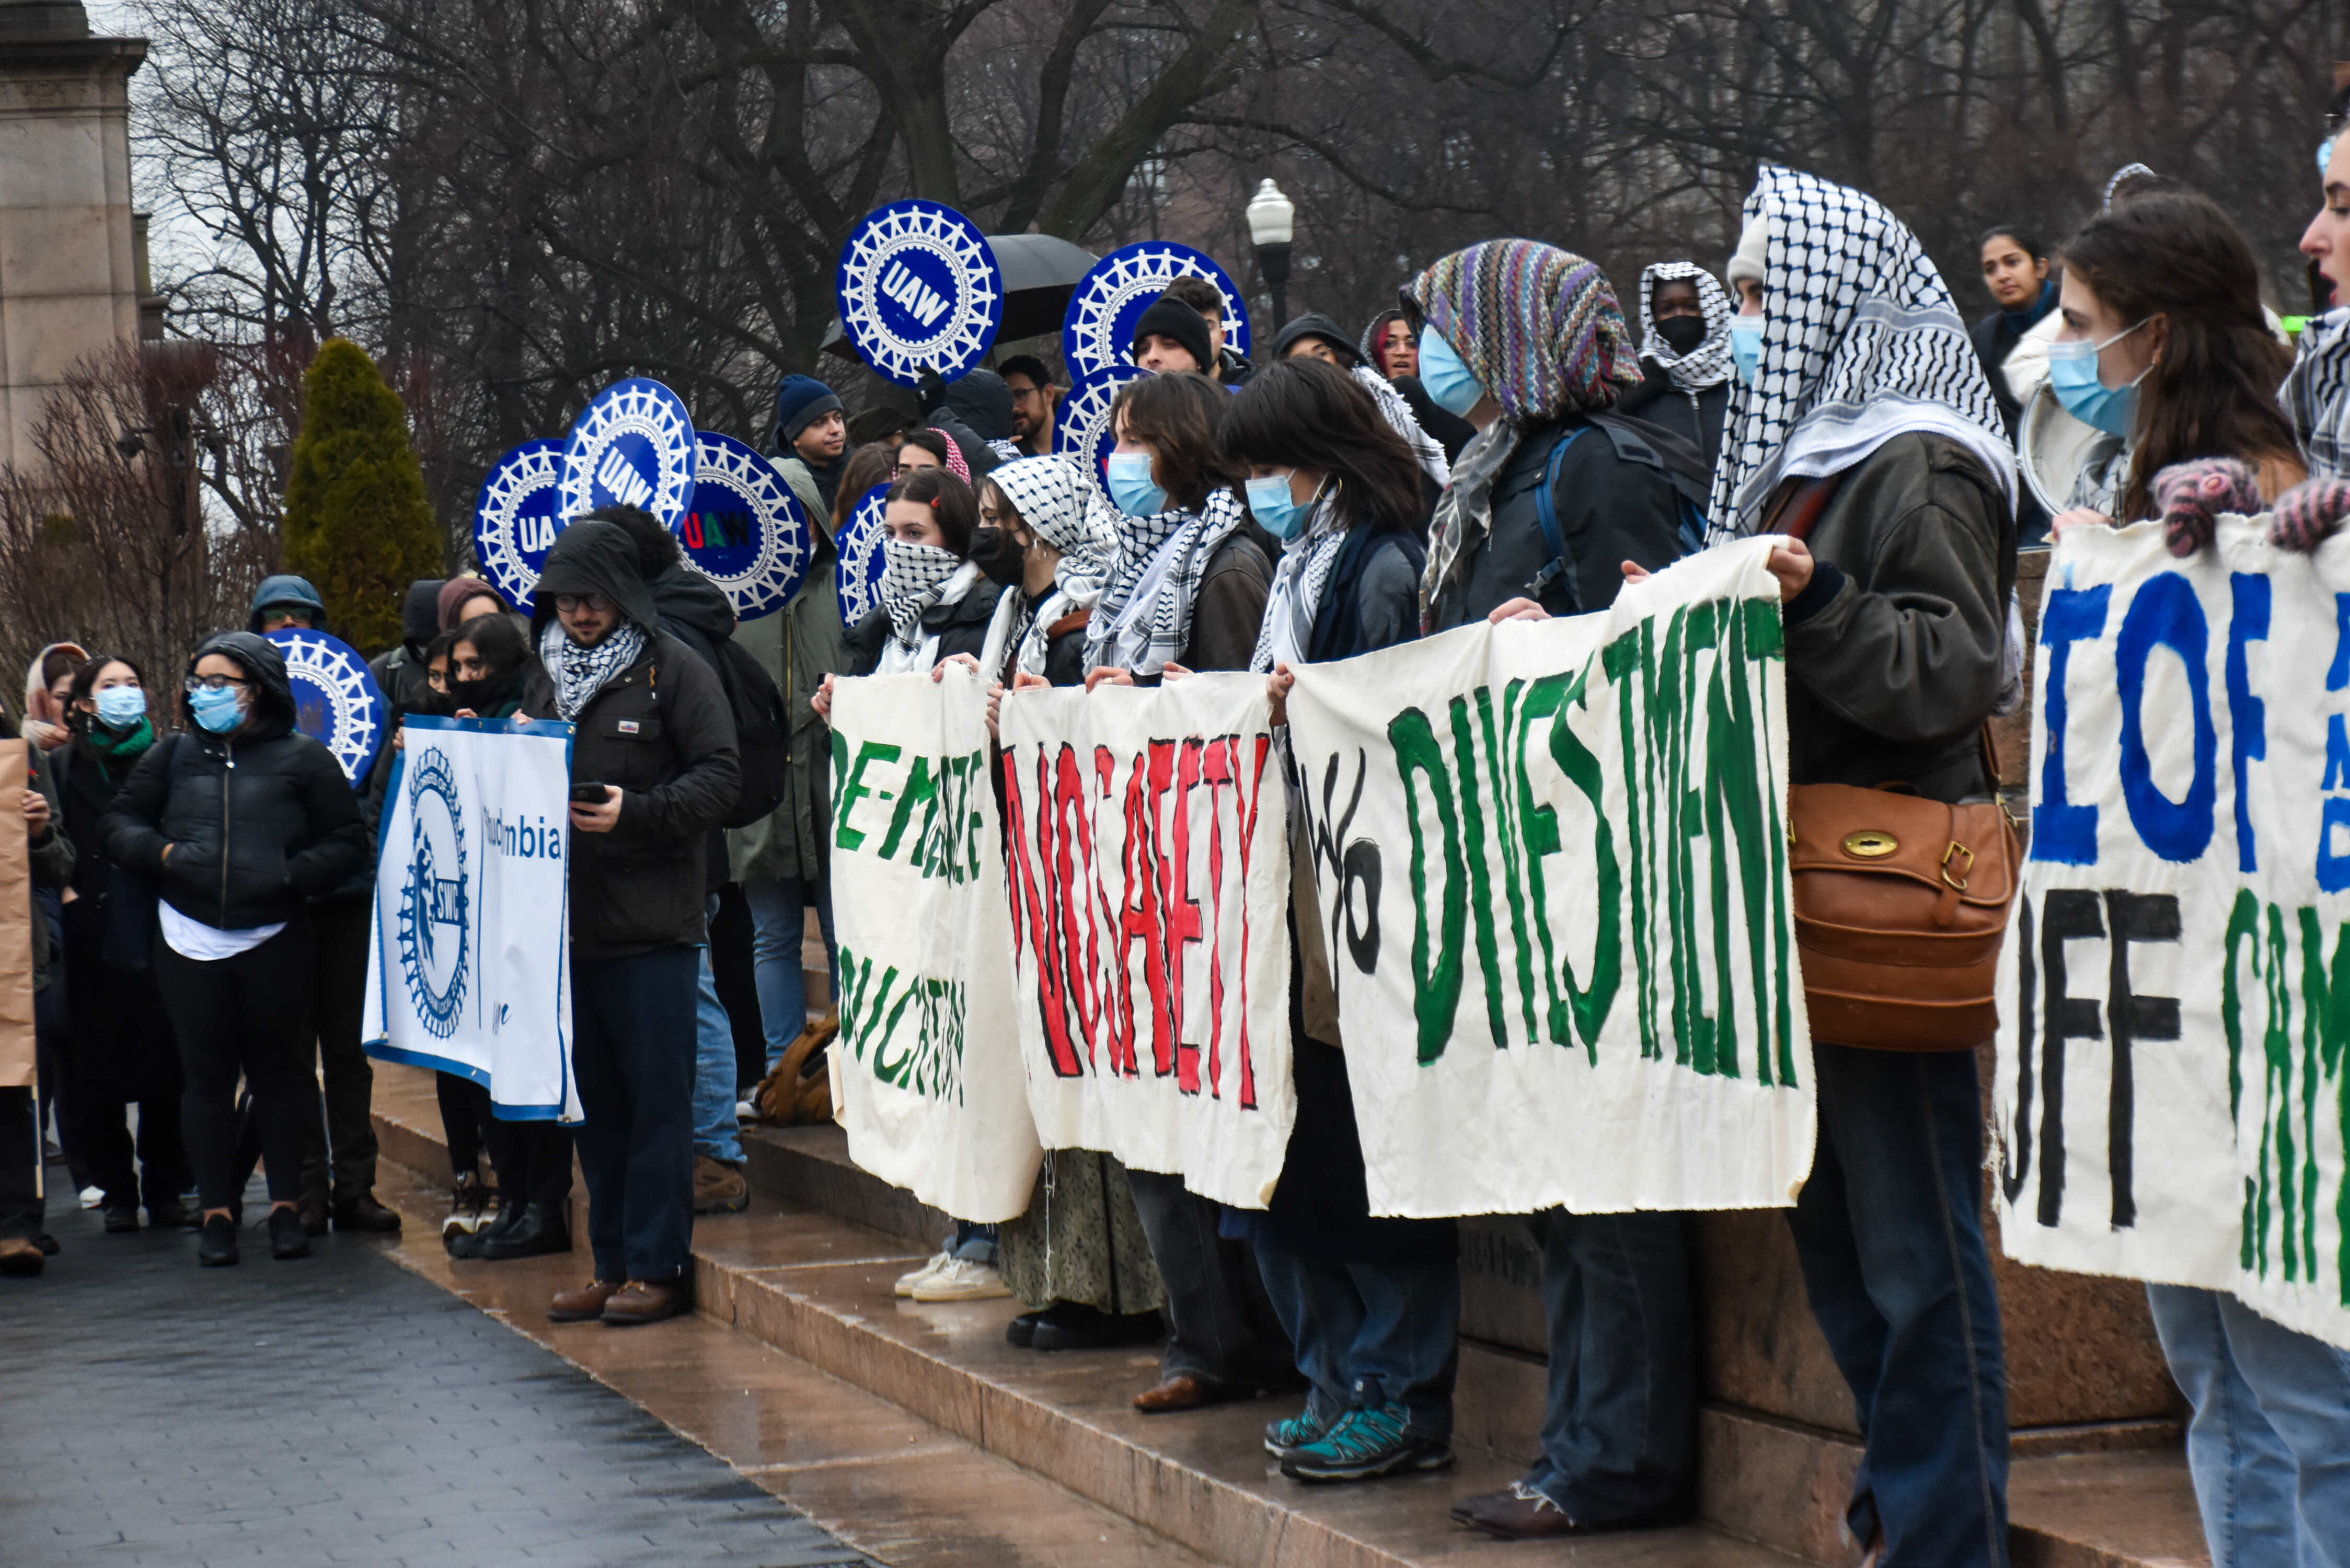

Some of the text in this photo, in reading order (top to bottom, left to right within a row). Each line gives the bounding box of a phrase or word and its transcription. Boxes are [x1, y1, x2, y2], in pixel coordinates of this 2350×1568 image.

[883, 235, 913, 251] AEROSPACE
[932, 239, 965, 275] AGRICULTURAL
[865, 295, 873, 318] UNITED
[882, 260, 950, 327] UAW
[944, 317, 964, 343] WORKERS
[1098, 334, 1109, 368] EROSPACE
[1105, 280, 1143, 313] AGRICULTURAL
[1083, 427, 1093, 464] AEROSPACE
[1093, 414, 1104, 426] AND
[597, 446, 653, 508] UAW
[736, 479, 766, 510] IMPLEMENT
[684, 512, 750, 549] UAW
[765, 512, 775, 547] WORKERS
[752, 558, 770, 580] AMERICA
[768, 547, 774, 556] OF
[1387, 594, 1799, 1089] DIVESTMENT
[437, 881, 458, 921] SWC
